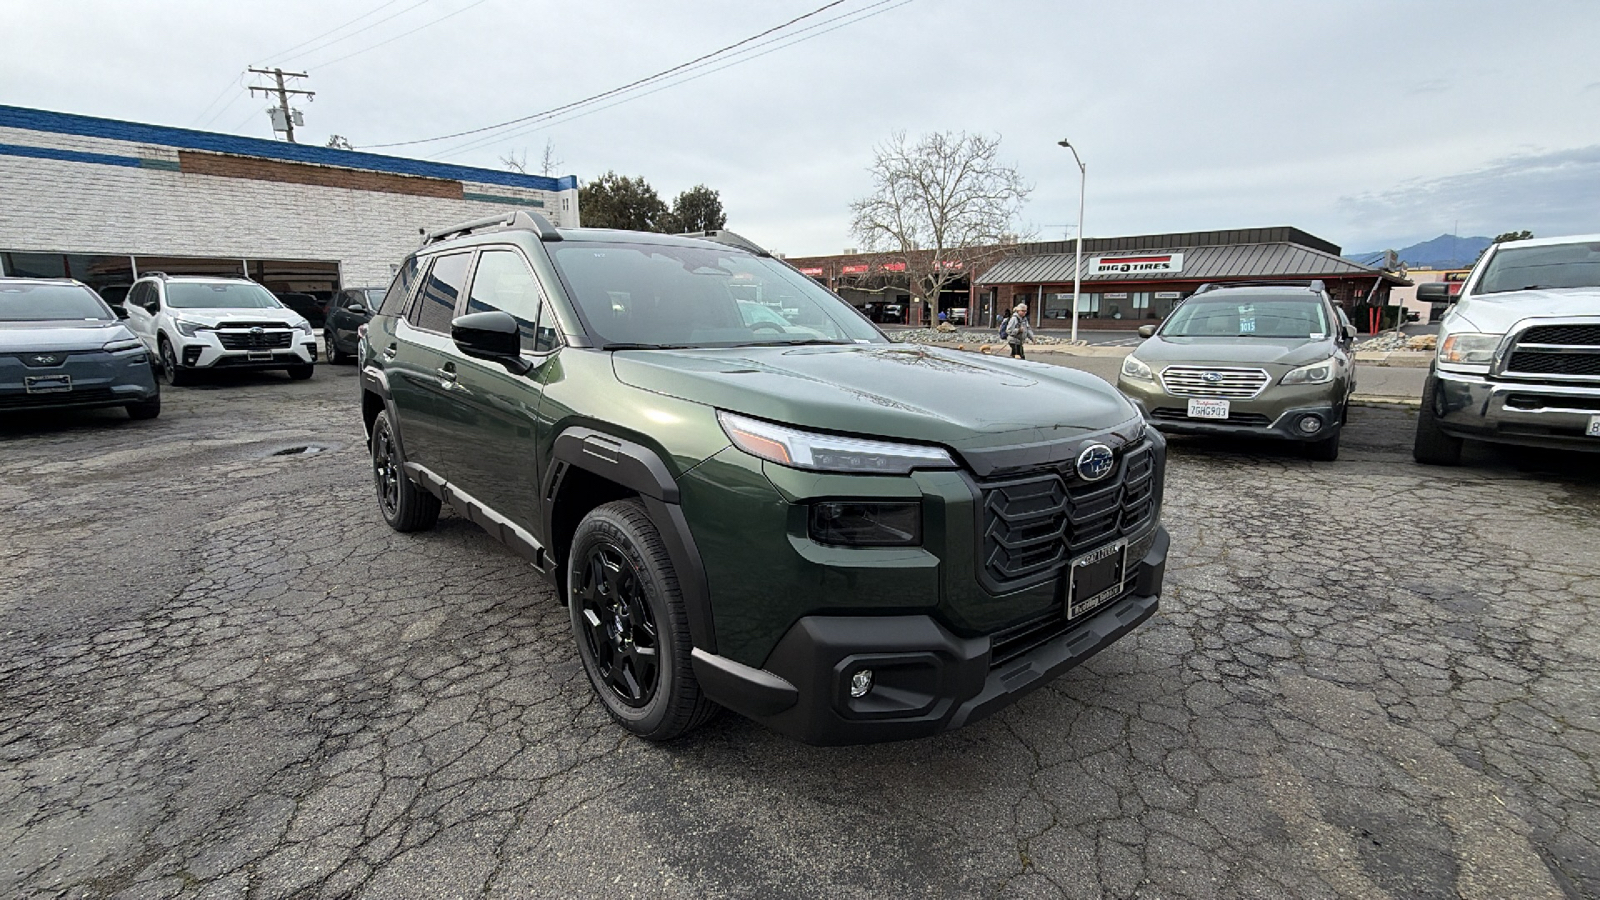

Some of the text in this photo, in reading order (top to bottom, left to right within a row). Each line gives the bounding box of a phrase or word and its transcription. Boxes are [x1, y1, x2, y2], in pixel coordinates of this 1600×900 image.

[1098, 264, 1119, 272] BIG
[1131, 262, 1170, 271] TIRES
[1240, 321, 1256, 332] 1015
[1191, 405, 1226, 417] 7GHG903
